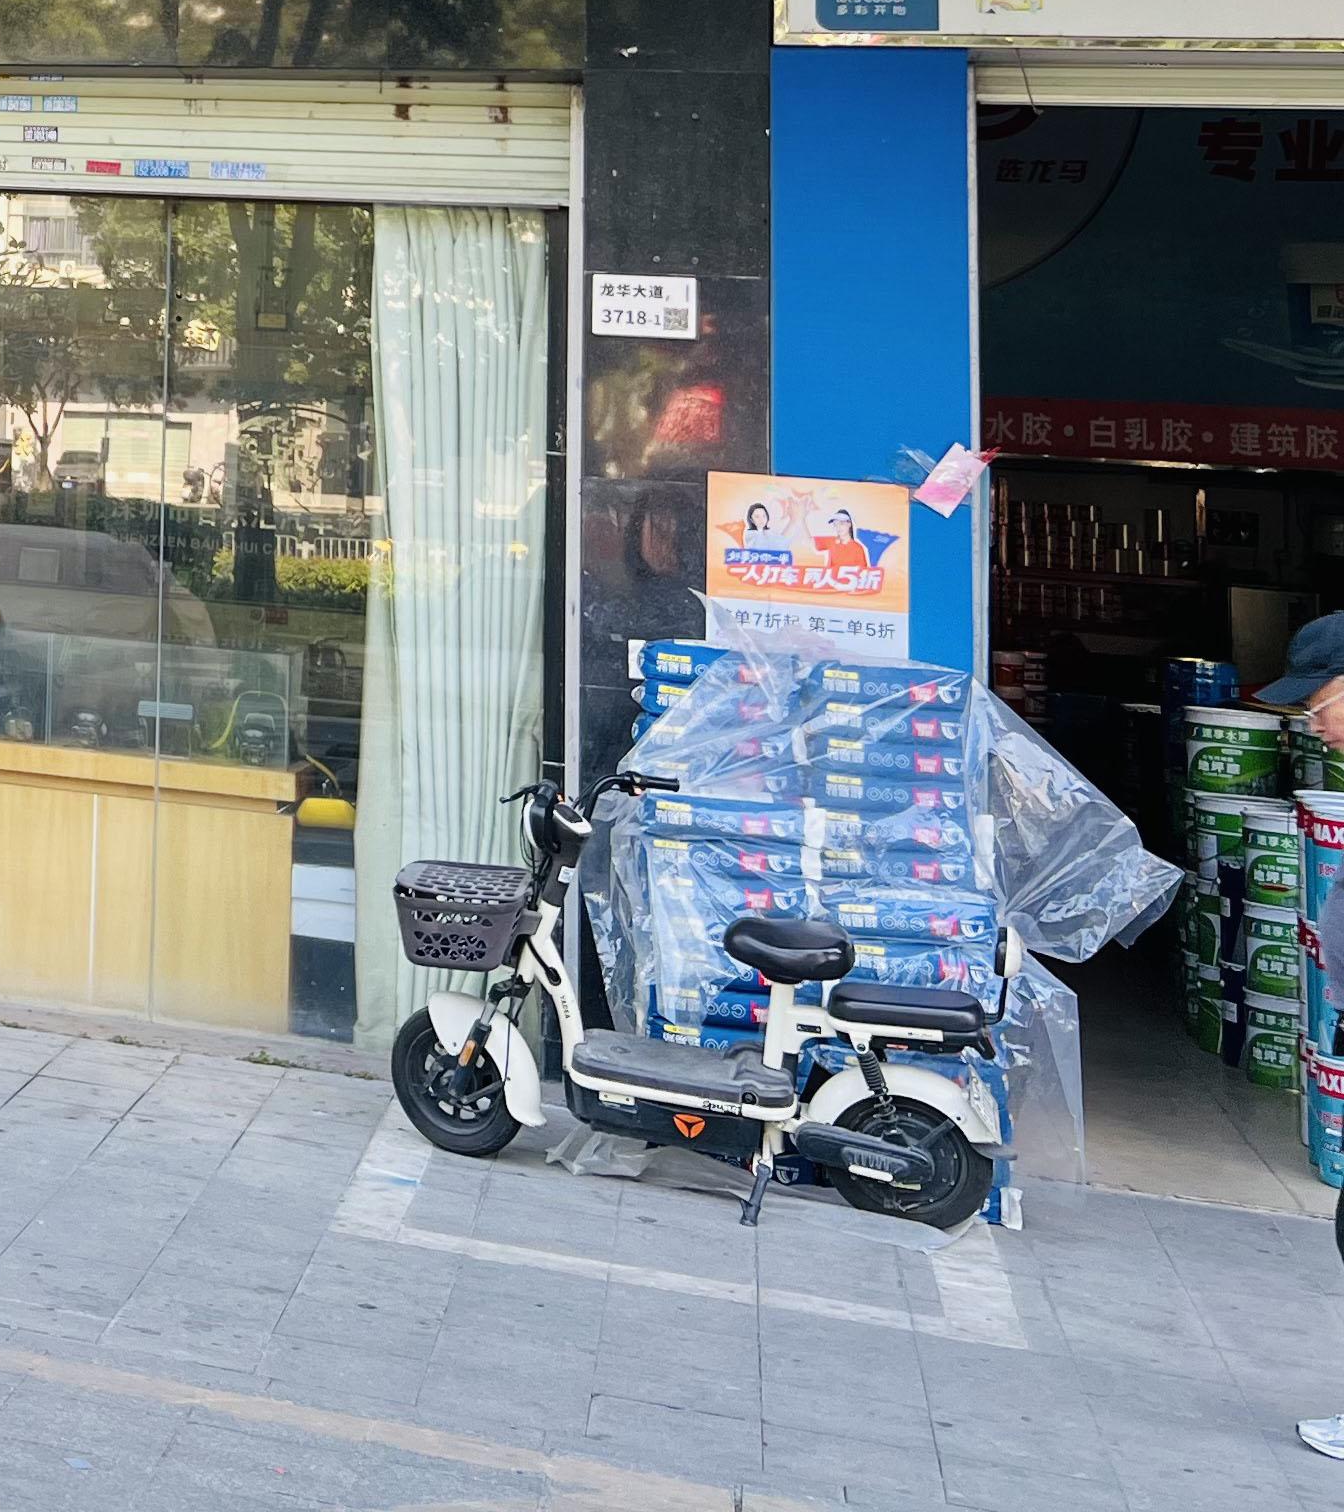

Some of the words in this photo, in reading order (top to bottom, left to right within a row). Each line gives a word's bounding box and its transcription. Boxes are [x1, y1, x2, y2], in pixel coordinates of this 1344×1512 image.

[599, 282, 665, 300] 龙华大道
[724, 607, 801, 630] 单7折起
[808, 615, 898, 640] 第二单5折
